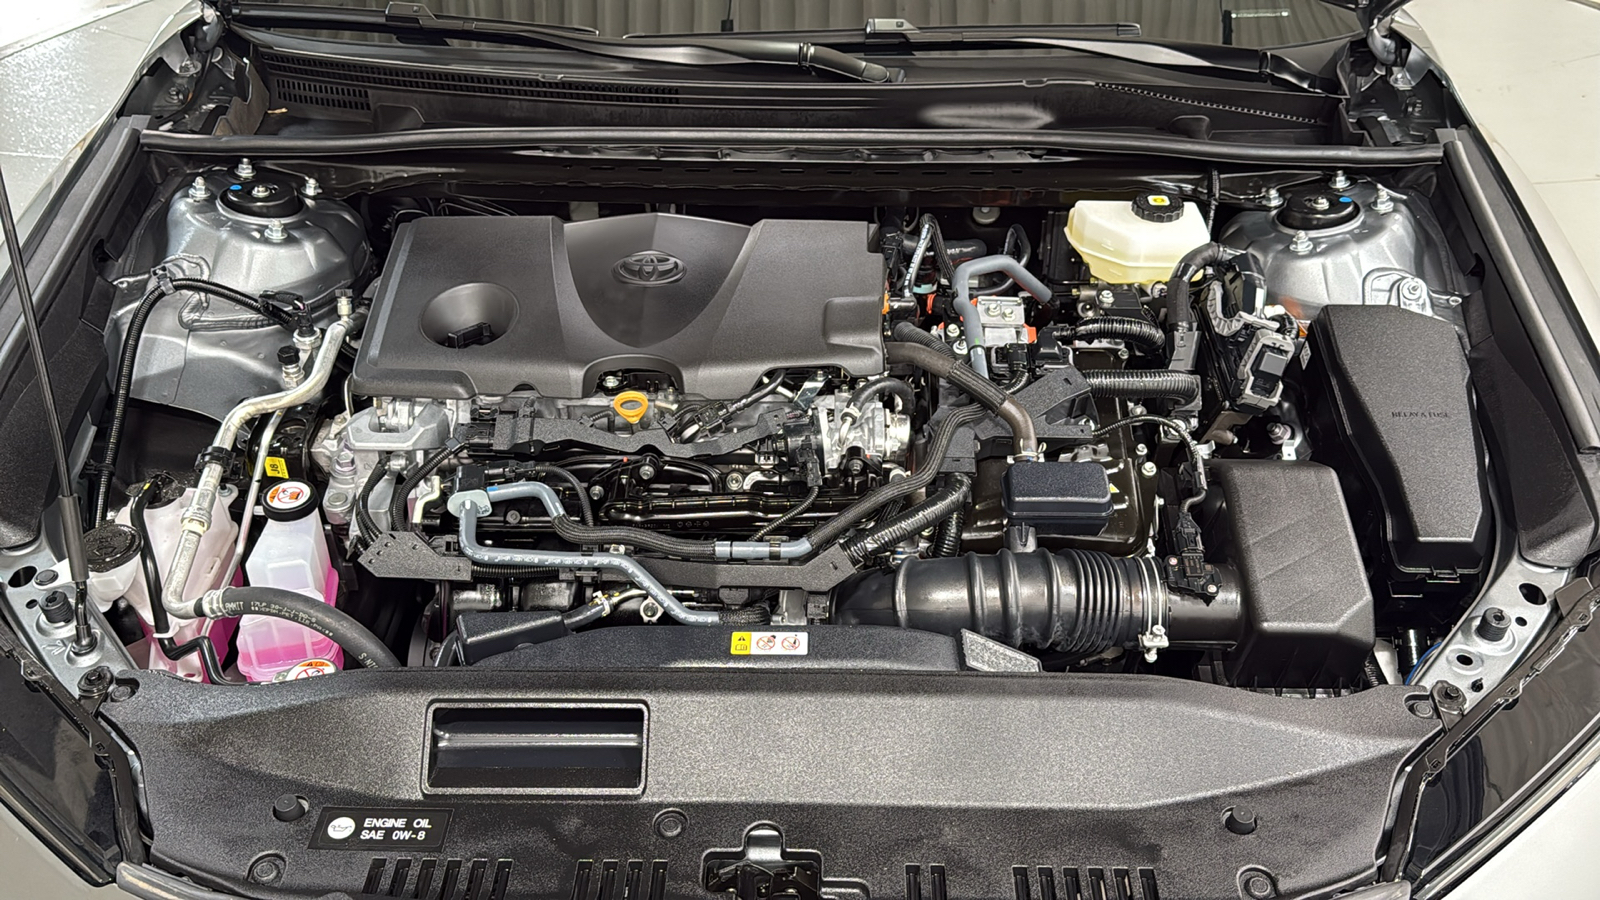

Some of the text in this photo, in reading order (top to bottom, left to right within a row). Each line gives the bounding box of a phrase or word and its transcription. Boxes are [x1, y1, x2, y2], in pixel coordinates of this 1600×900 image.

[363, 817, 432, 828] ENGINE OIL
[360, 829, 426, 840] SAE 0W-8
